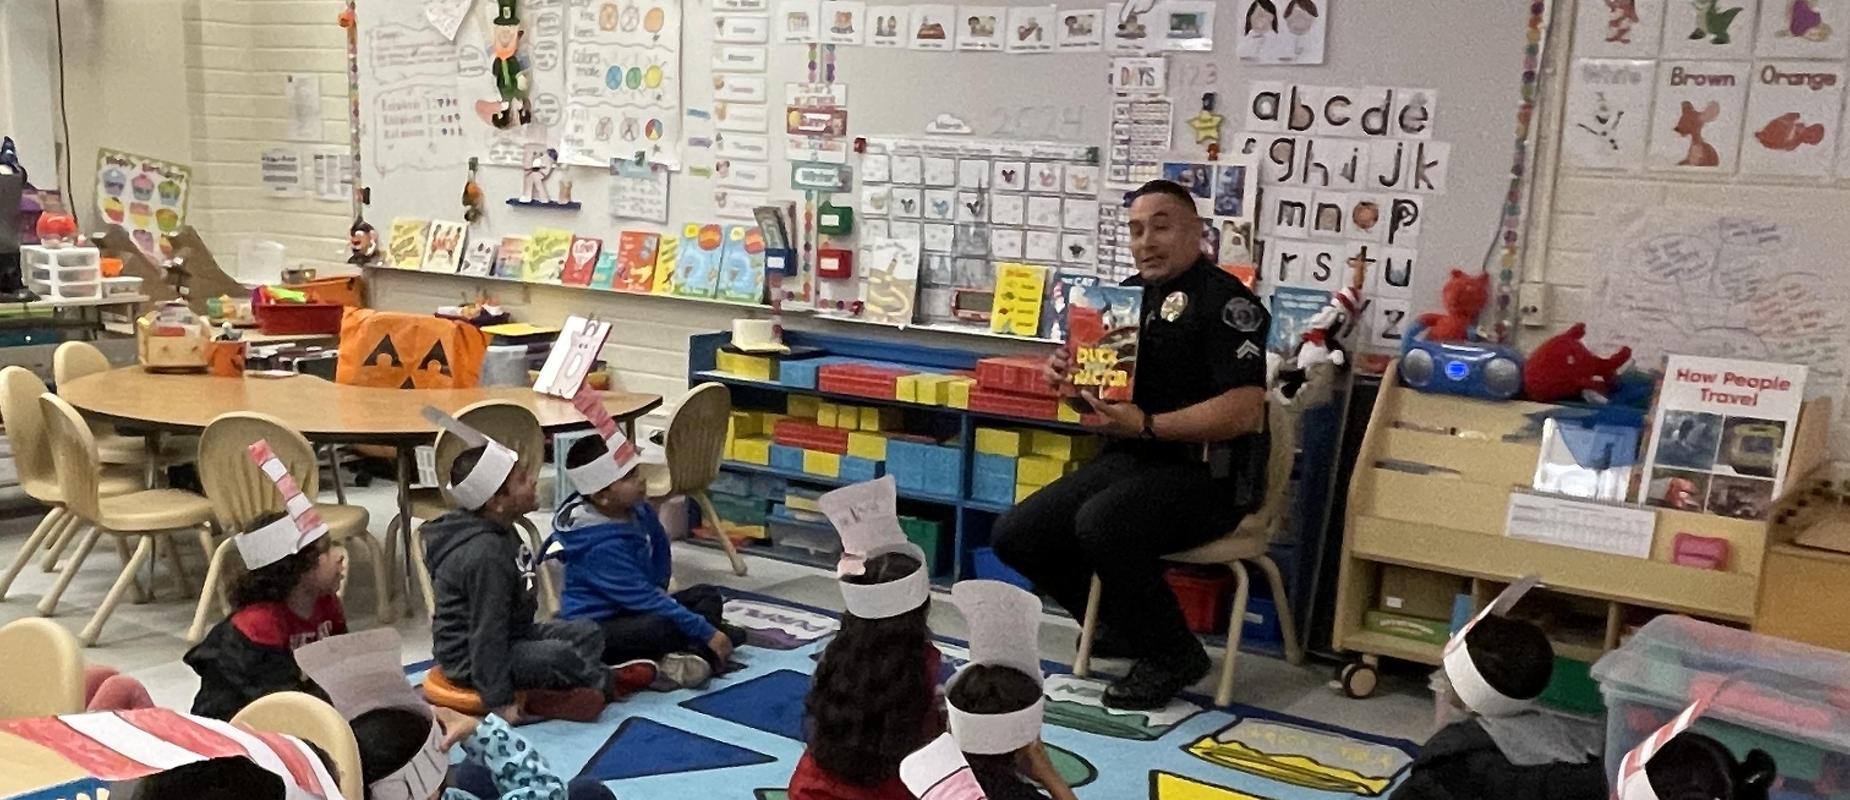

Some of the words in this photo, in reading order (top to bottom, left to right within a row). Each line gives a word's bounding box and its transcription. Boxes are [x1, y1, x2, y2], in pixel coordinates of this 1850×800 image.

[1670, 66, 1735, 87] Brown
[1761, 65, 1836, 90] Orange
[1253, 91, 1281, 121] a
[1288, 85, 1315, 131] b
[1324, 95, 1352, 126] c
[1361, 89, 1392, 136] d
[1398, 104, 1428, 134] e
[1269, 137, 1295, 182] g
[1303, 140, 1328, 186] h
[1379, 142, 1403, 187] j
[1415, 142, 1439, 190] k
[1315, 203, 1342, 232] n
[1388, 198, 1418, 244] p
[1279, 252, 1298, 281] r
[1313, 252, 1331, 282] s
[1385, 257, 1412, 287] u
[1382, 310, 1404, 340] z
[1077, 346, 1119, 364] DUCK
[1677, 368, 1717, 384] How
[1723, 371, 1791, 391] People
[1700, 387, 1758, 407] Travel
